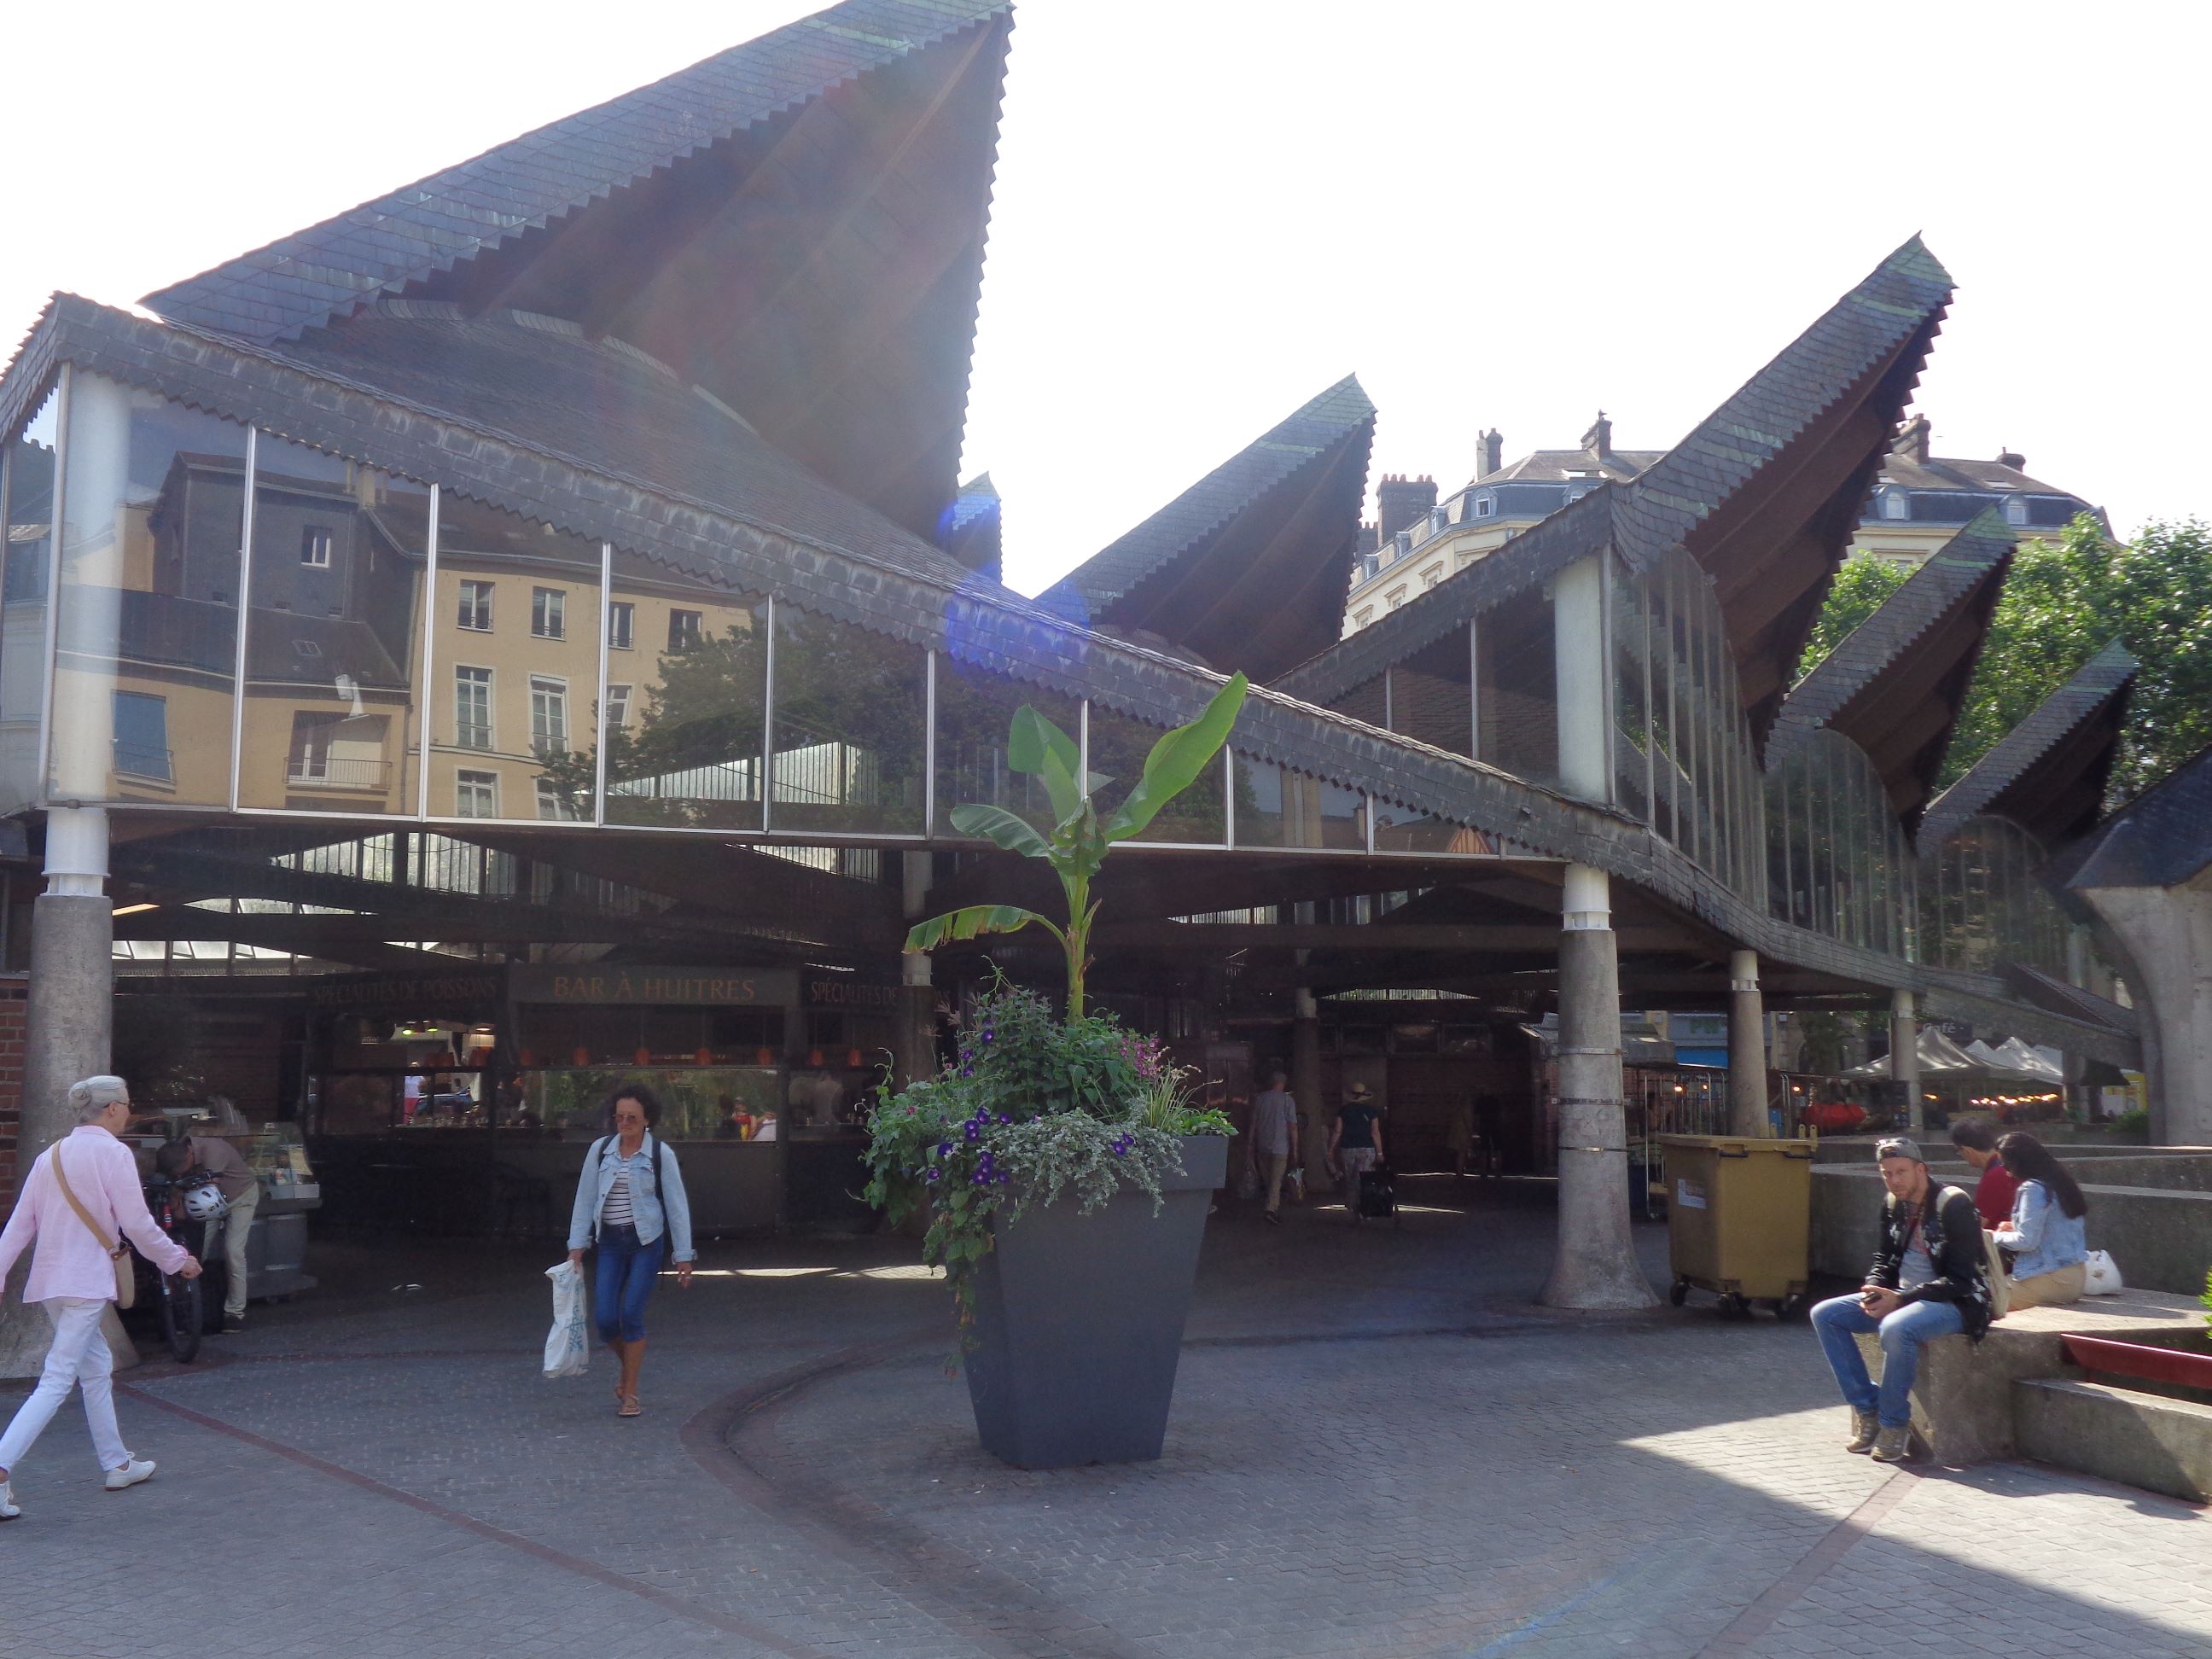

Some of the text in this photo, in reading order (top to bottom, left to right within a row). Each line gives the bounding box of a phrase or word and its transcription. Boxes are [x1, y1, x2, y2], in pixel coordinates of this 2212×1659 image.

[399, 981, 418, 1001] DE
[423, 976, 497, 999] POISSONS
[554, 970, 755, 1000] BAR À HUITRES
[883, 987, 899, 1006] DE
